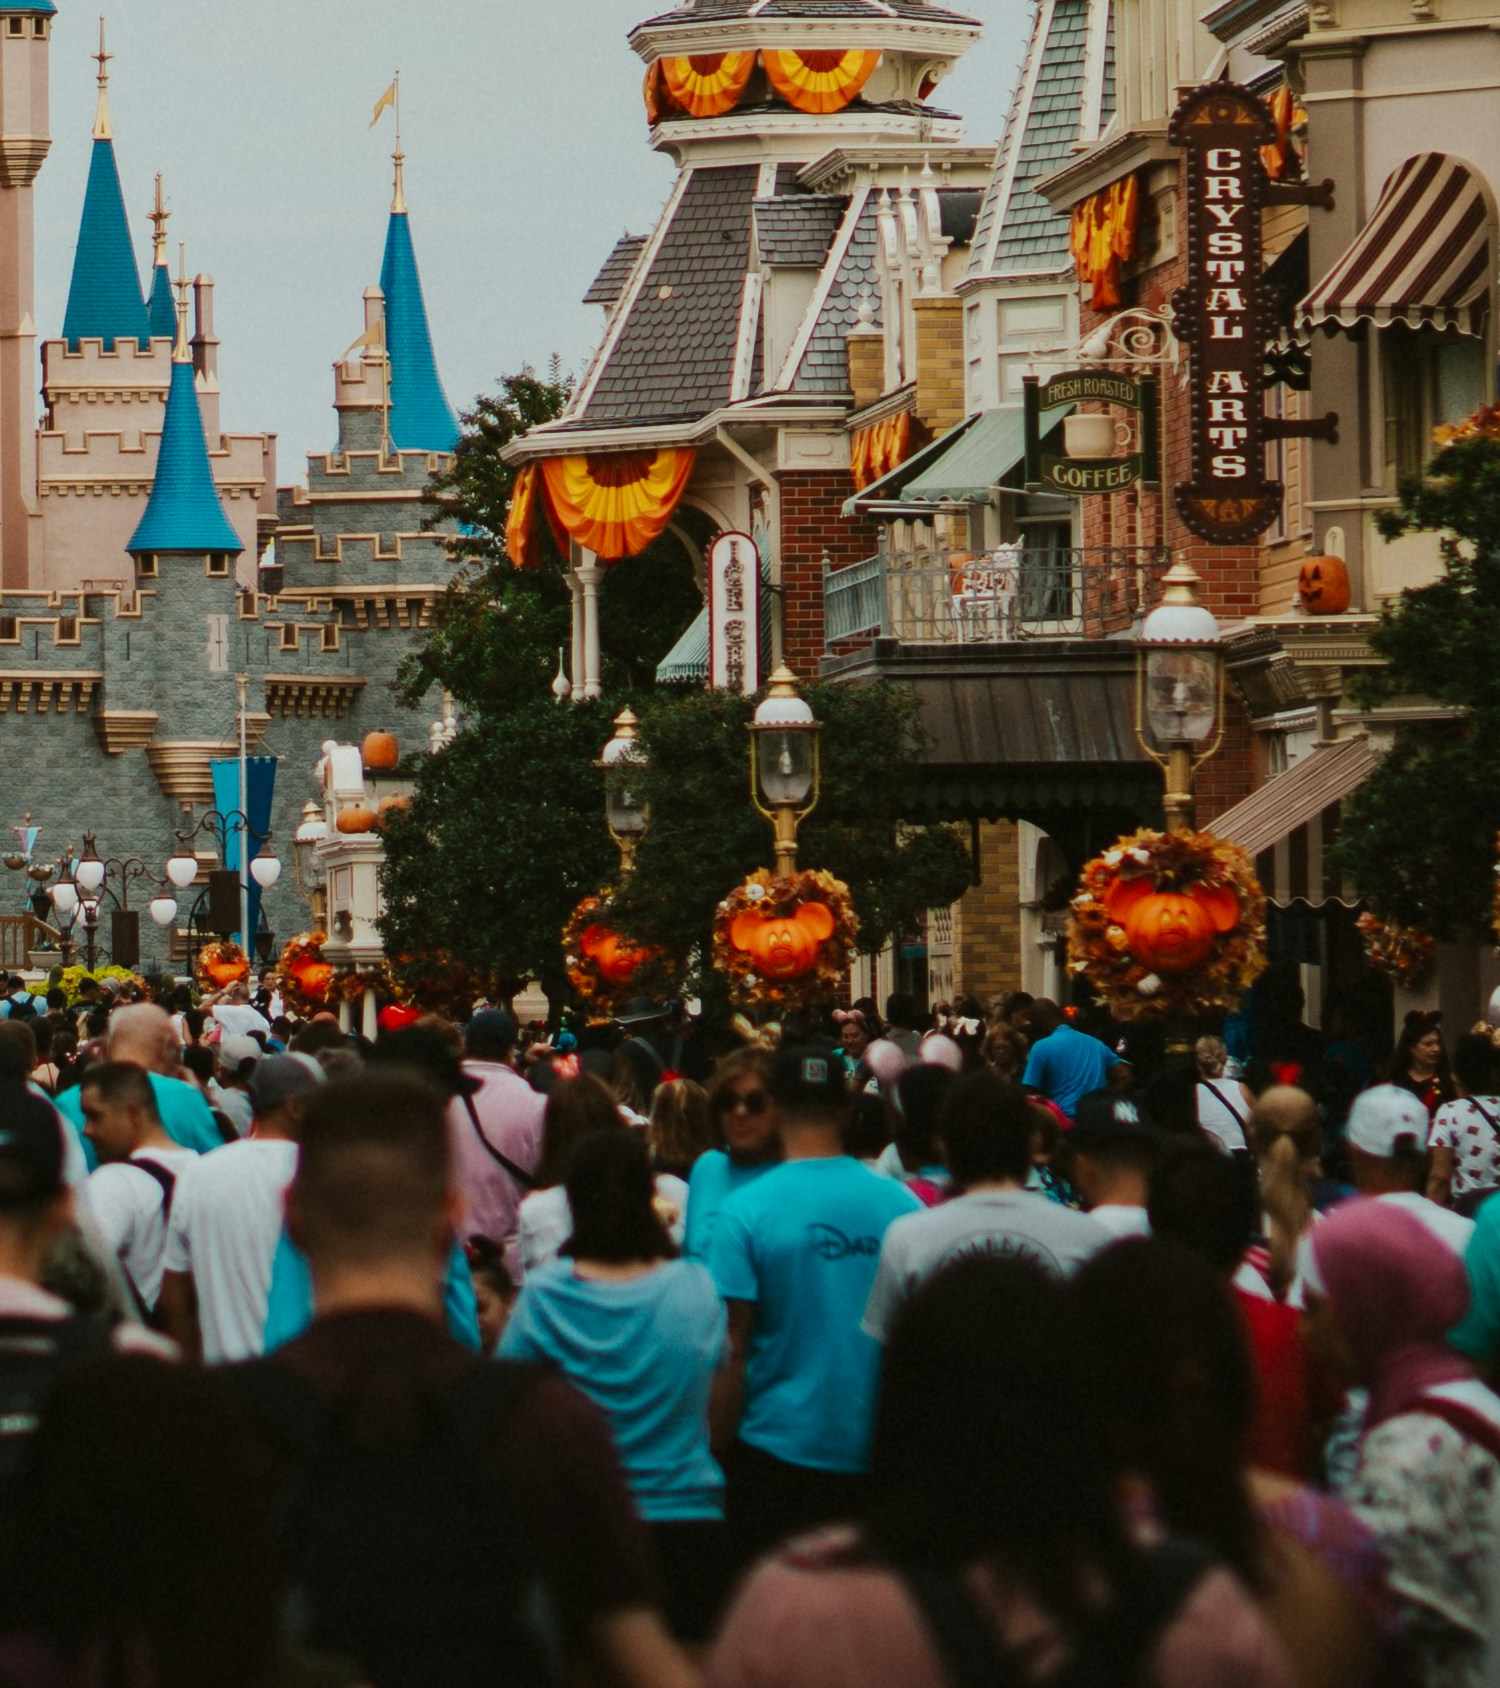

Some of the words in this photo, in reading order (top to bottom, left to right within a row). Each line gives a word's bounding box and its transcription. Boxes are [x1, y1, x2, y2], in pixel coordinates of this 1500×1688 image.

[1205, 148, 1246, 339] CRYSTAL
[1048, 379, 1081, 403] FRESH
[1084, 378, 1134, 401] ROASTED
[1207, 371, 1248, 477] ARTS
[1053, 463, 1131, 488] COFFEE
[723, 541, 744, 611] ICE
[723, 619, 745, 692] CRE
